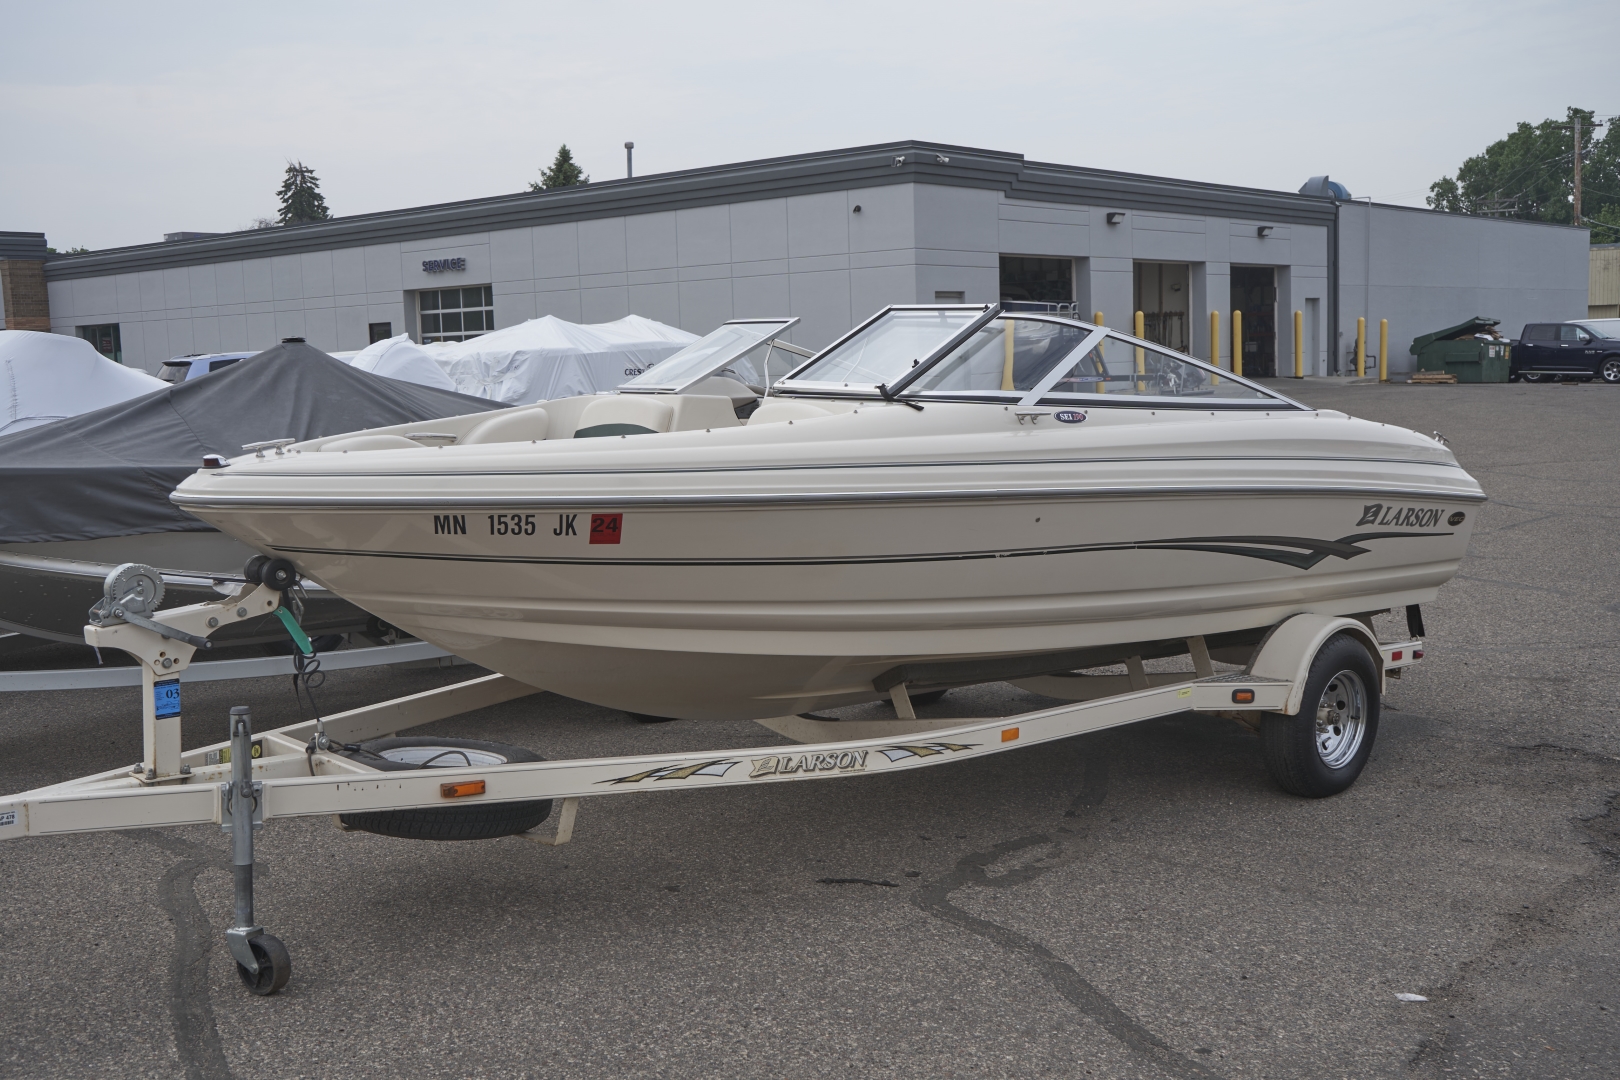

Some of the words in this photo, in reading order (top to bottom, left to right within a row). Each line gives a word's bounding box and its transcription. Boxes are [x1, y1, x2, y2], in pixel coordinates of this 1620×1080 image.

[422, 257, 466, 272] SERVICE
[433, 514, 467, 535] MN
[487, 514, 536, 536] 1535
[553, 514, 578, 536] JK
[591, 517, 619, 533] 24
[1377, 506, 1445, 528] LARSON
[165, 688, 180, 699] 03
[778, 750, 869, 774] LARSON
